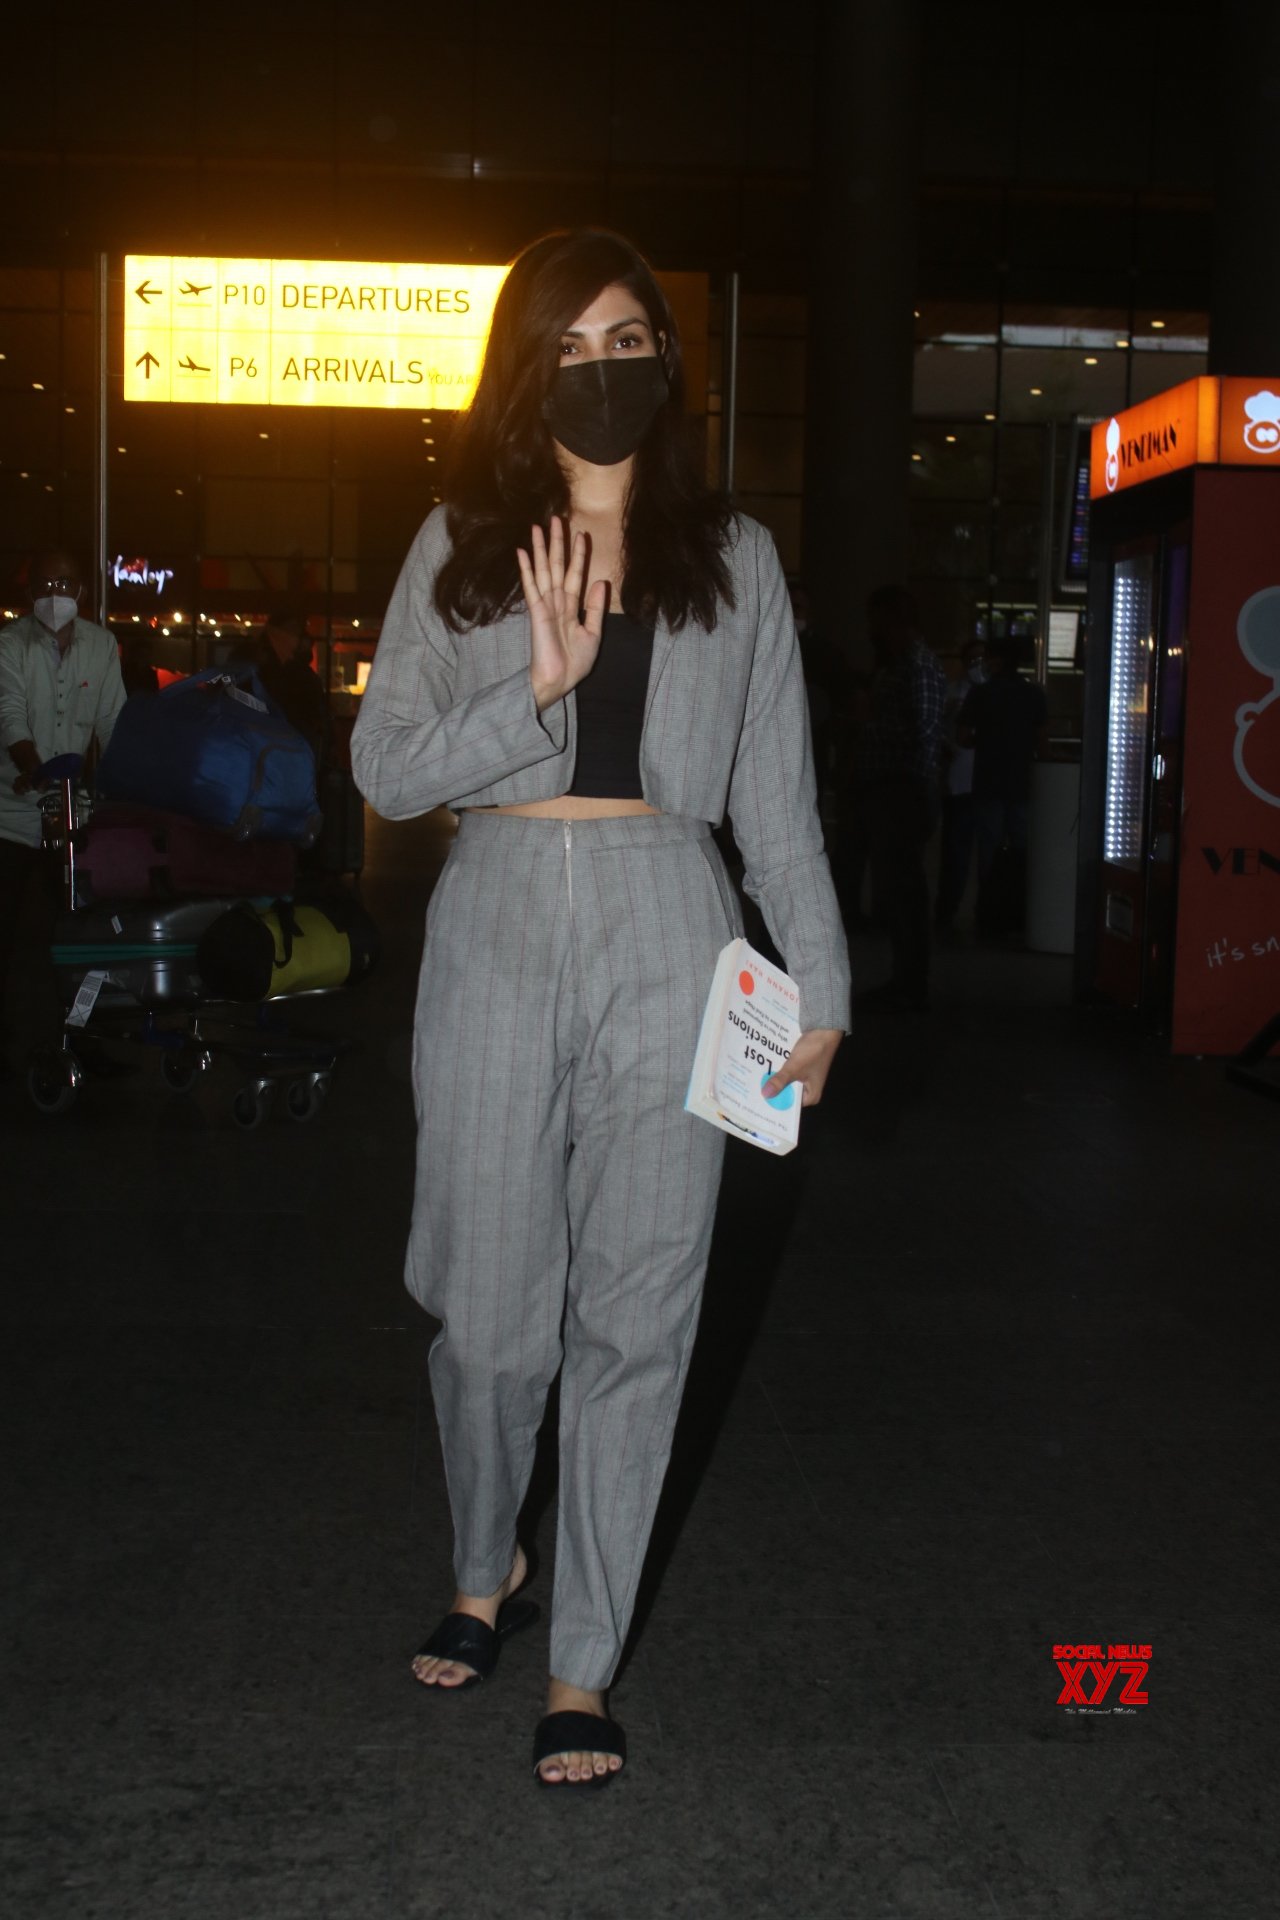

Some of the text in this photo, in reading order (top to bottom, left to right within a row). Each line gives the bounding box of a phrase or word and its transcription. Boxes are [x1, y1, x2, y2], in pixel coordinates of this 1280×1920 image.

[224, 285, 471, 313] P10 DEPARTURES
[230, 357, 424, 384] P6 ARRIVALS
[728, 1010, 791, 1059] onnections
[744, 1045, 772, 1075] Lost
